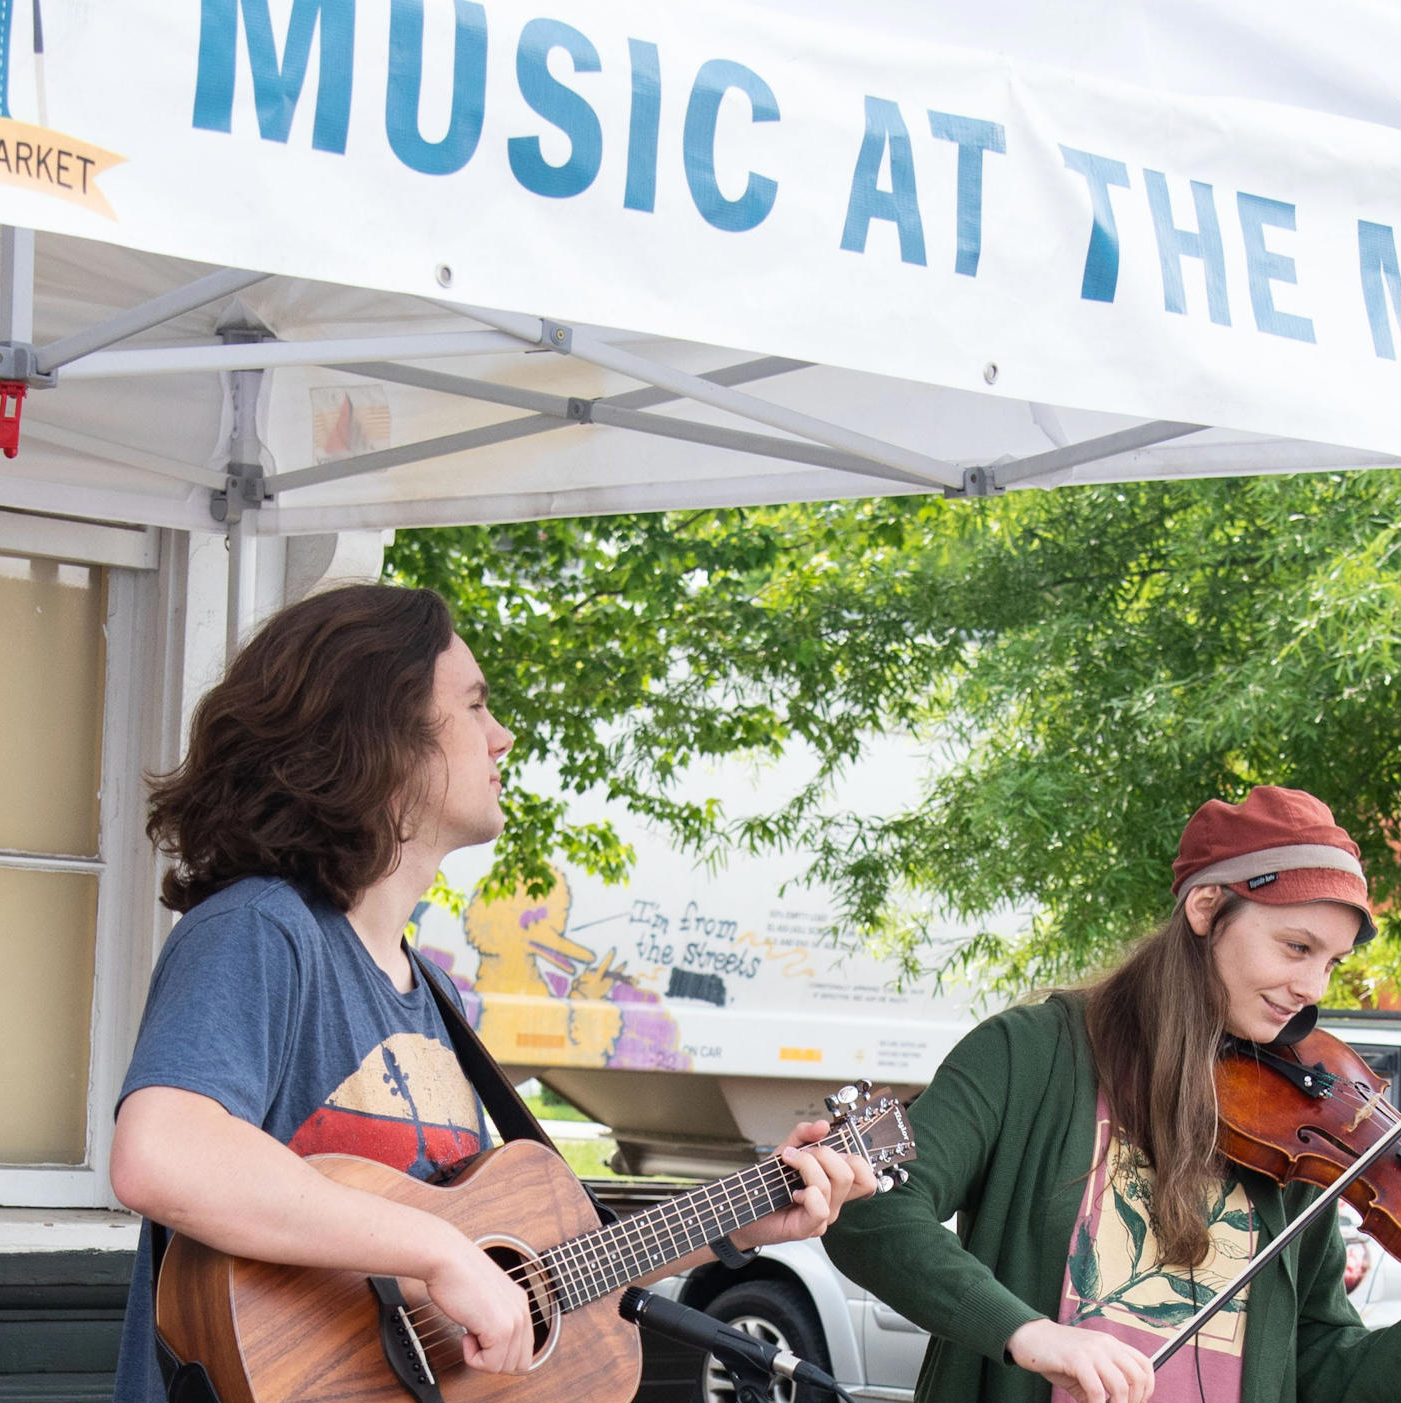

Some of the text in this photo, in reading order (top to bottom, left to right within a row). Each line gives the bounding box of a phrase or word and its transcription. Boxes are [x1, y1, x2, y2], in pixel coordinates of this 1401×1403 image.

[192, 0, 781, 233] MUSIC
[840, 95, 1006, 278] AT
[1059, 144, 1317, 345] THE
[630, 899, 669, 935] I'm
[679, 900, 738, 942] from
[636, 932, 762, 979] the streets
[894, 1105, 910, 1141] Taylor
